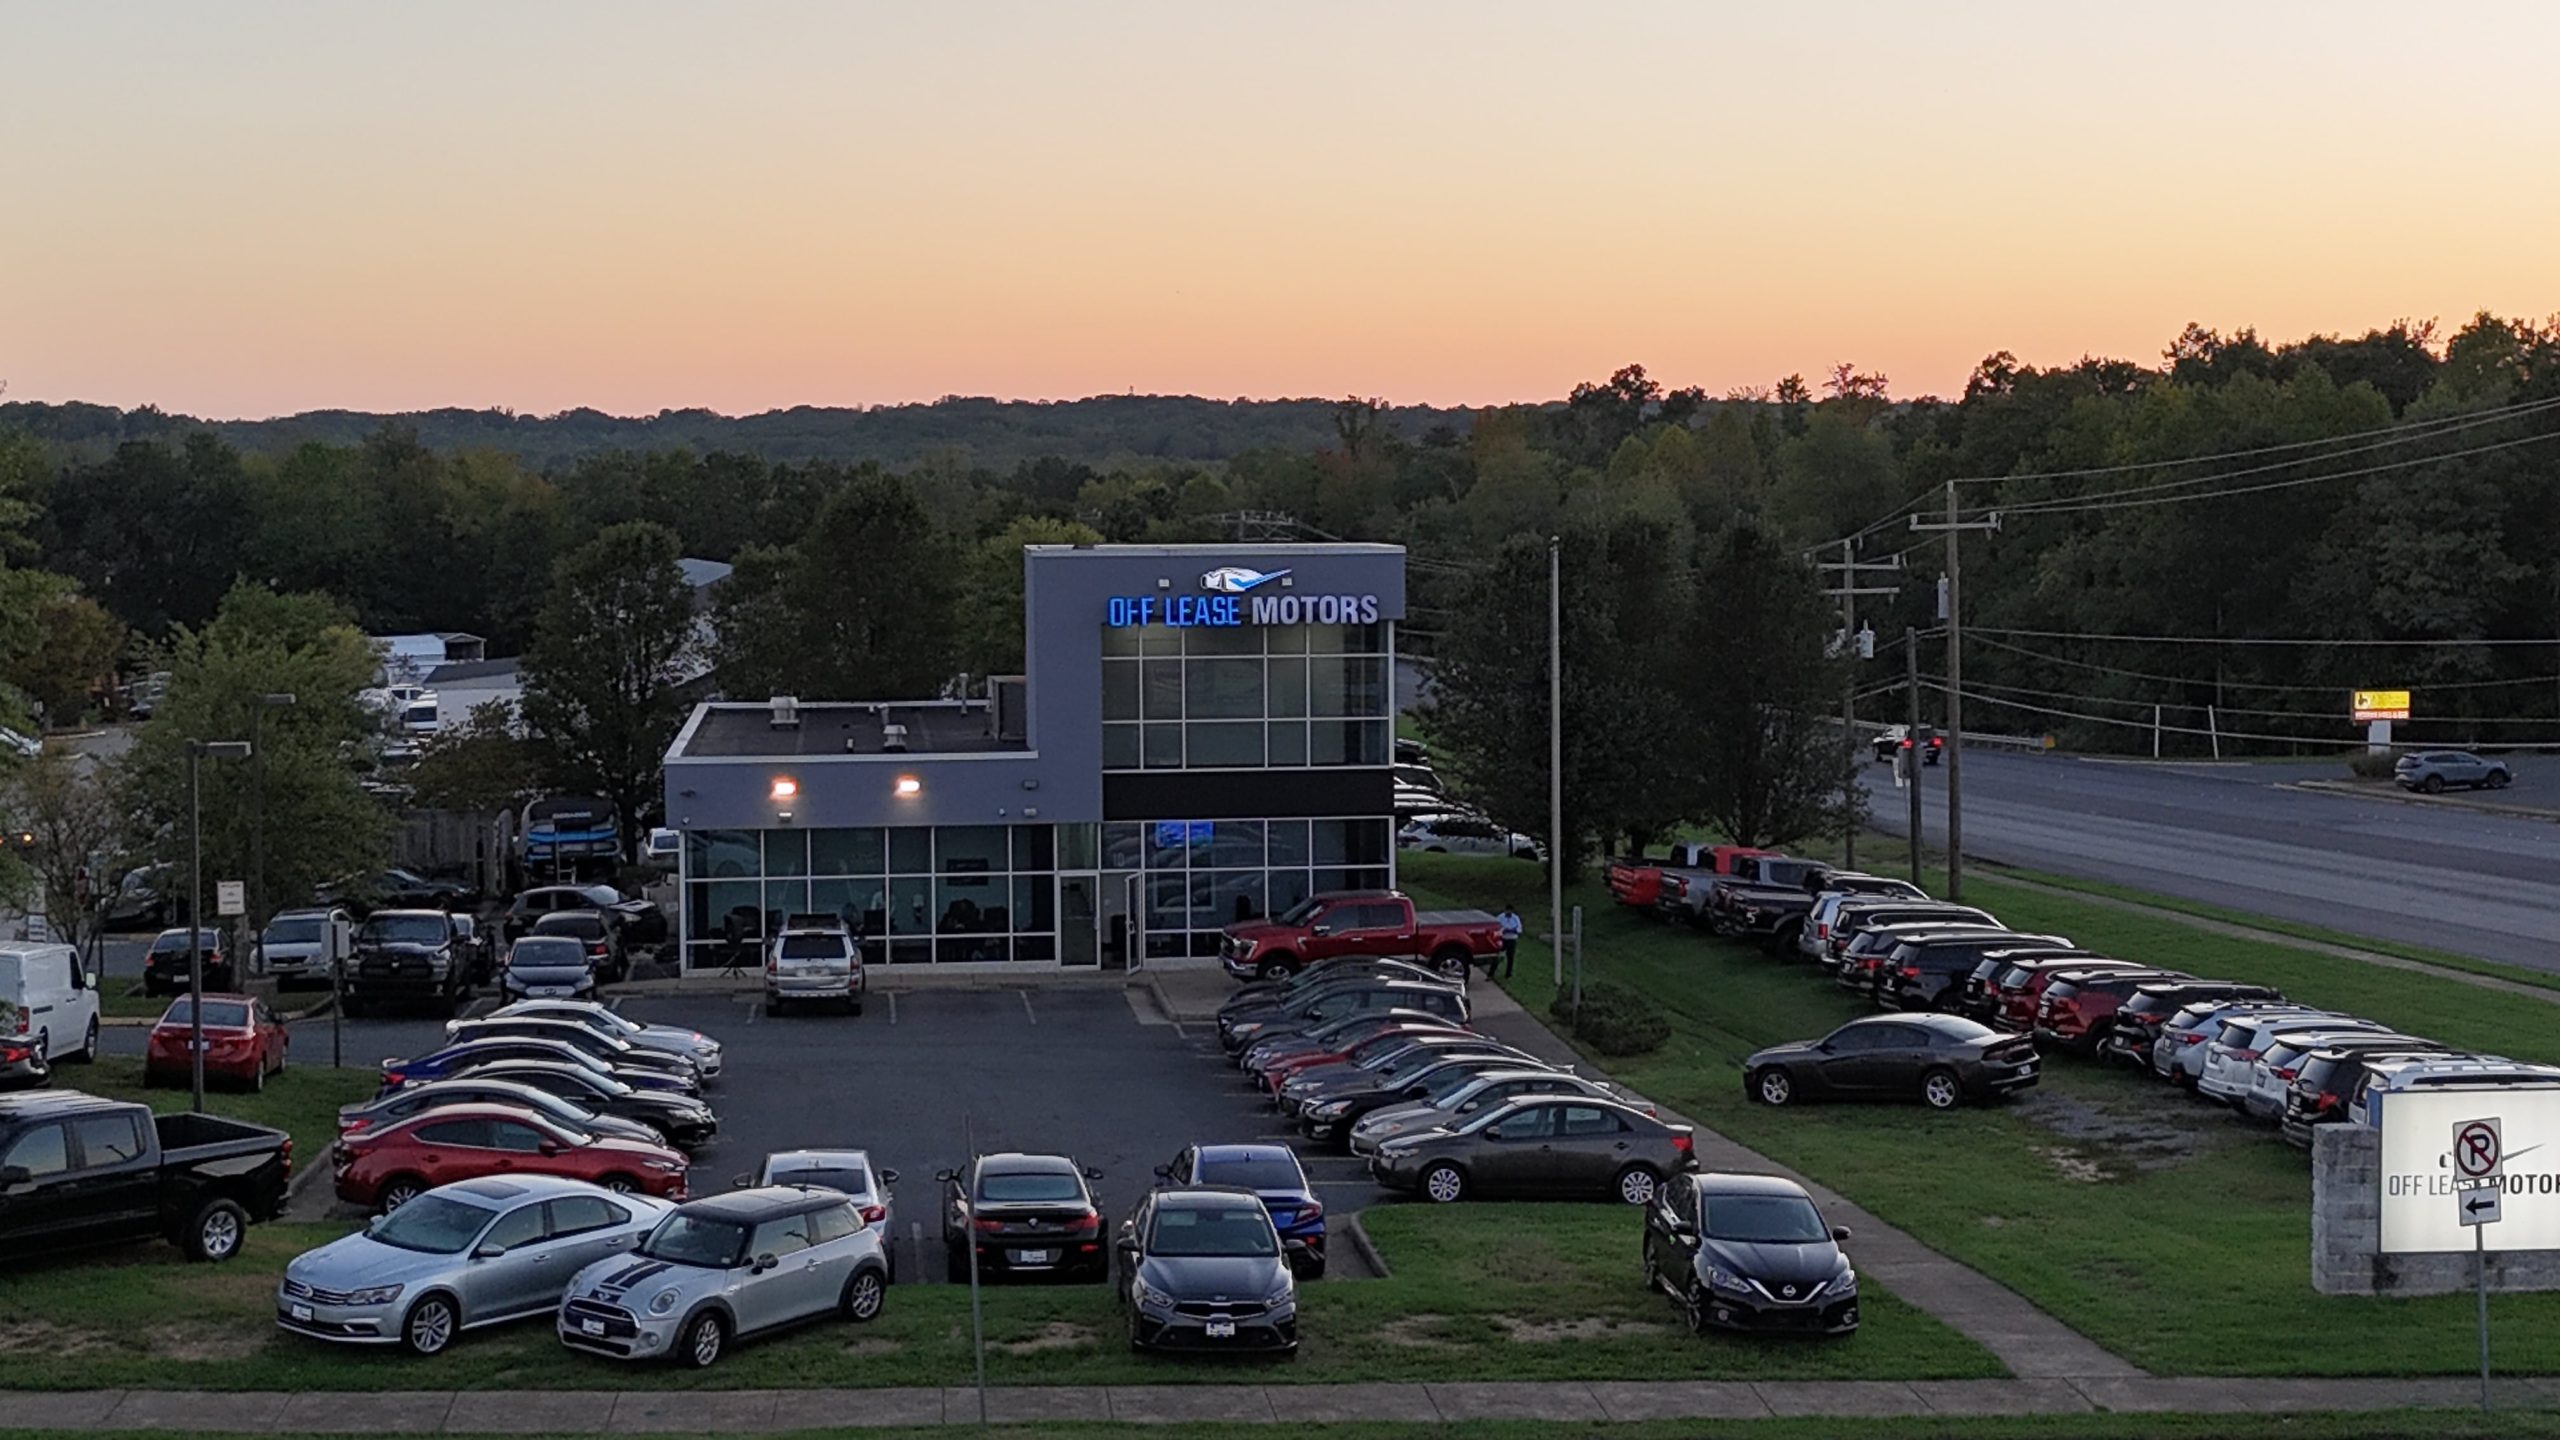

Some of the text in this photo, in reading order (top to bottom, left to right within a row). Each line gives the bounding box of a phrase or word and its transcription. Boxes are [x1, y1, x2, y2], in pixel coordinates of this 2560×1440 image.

[1109, 595, 1379, 626] OFF LEASE MOTORS
[2389, 1174, 2423, 1196] OFF
